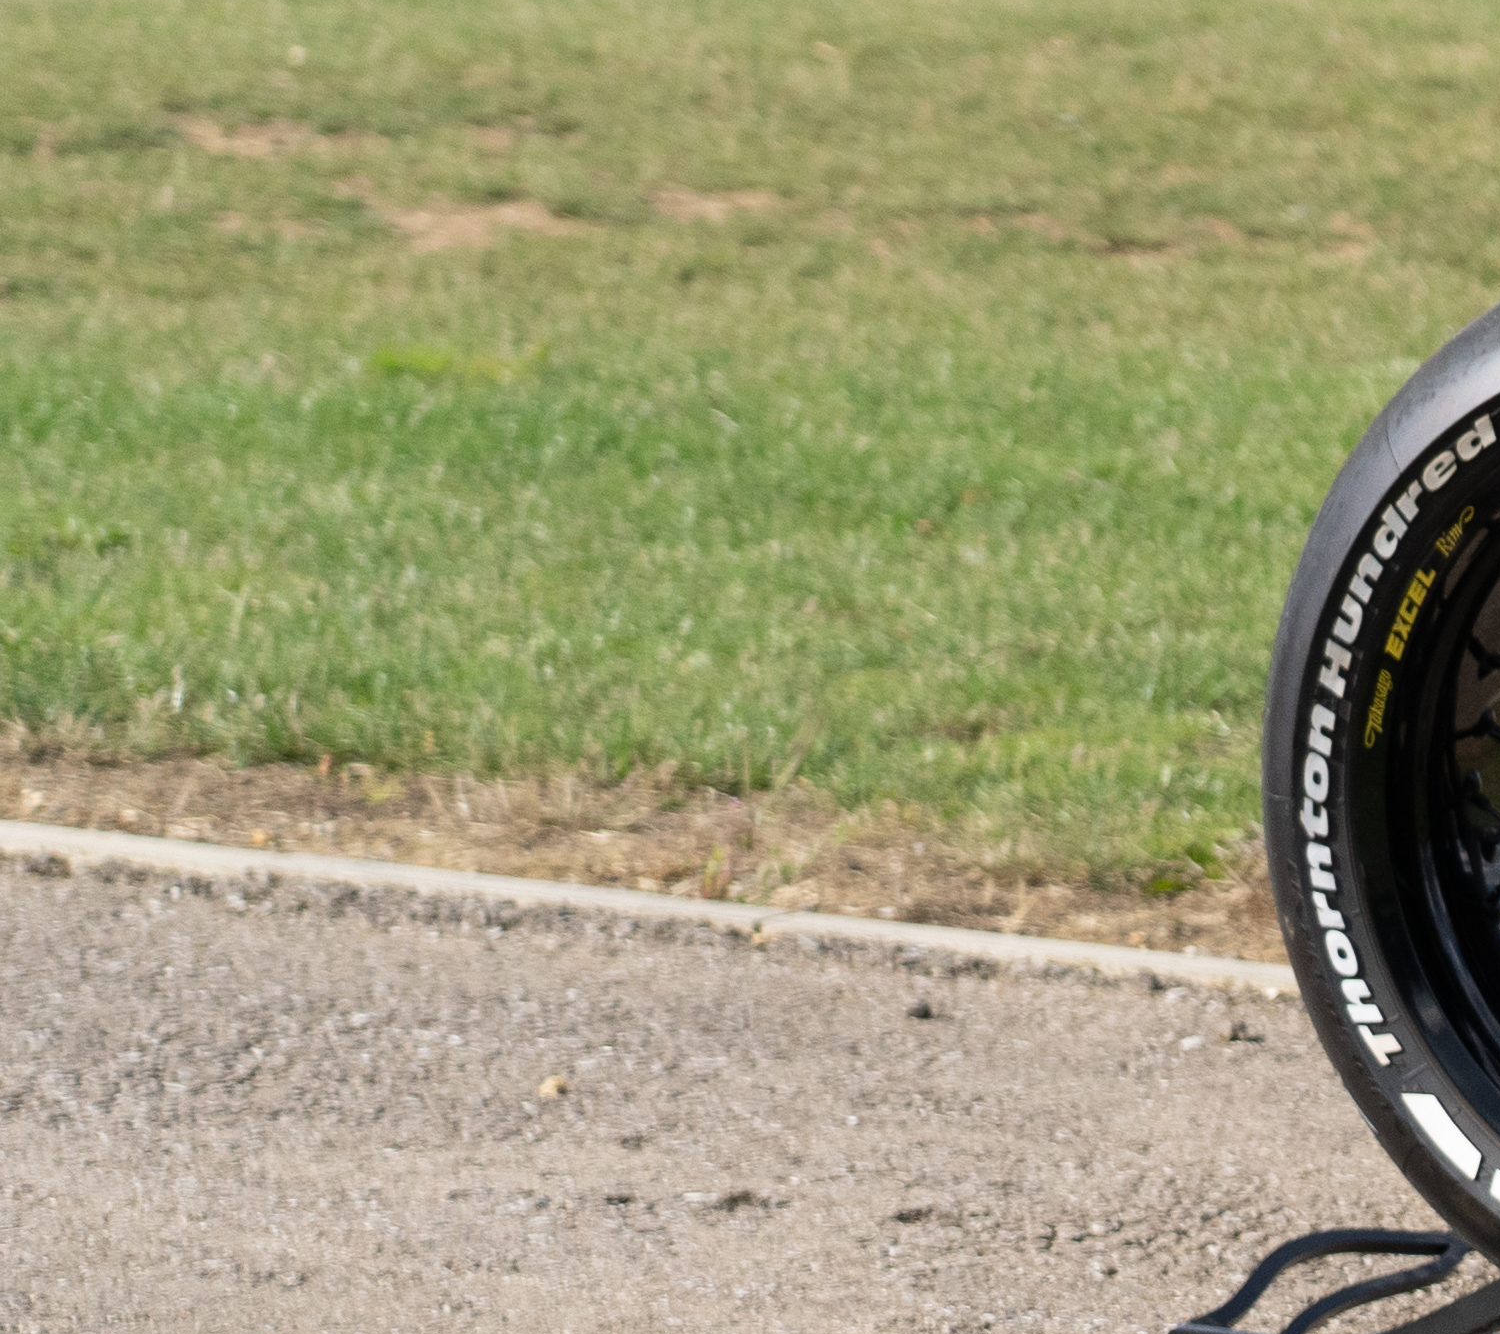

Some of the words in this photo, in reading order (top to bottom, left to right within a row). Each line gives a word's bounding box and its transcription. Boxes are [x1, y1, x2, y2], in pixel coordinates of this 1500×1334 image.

[1318, 413, 1498, 699] Hundred
[1384, 568, 1437, 662] EXCEL
[1434, 505, 1475, 558] Rim
[1299, 703, 1403, 1068] Thornton
